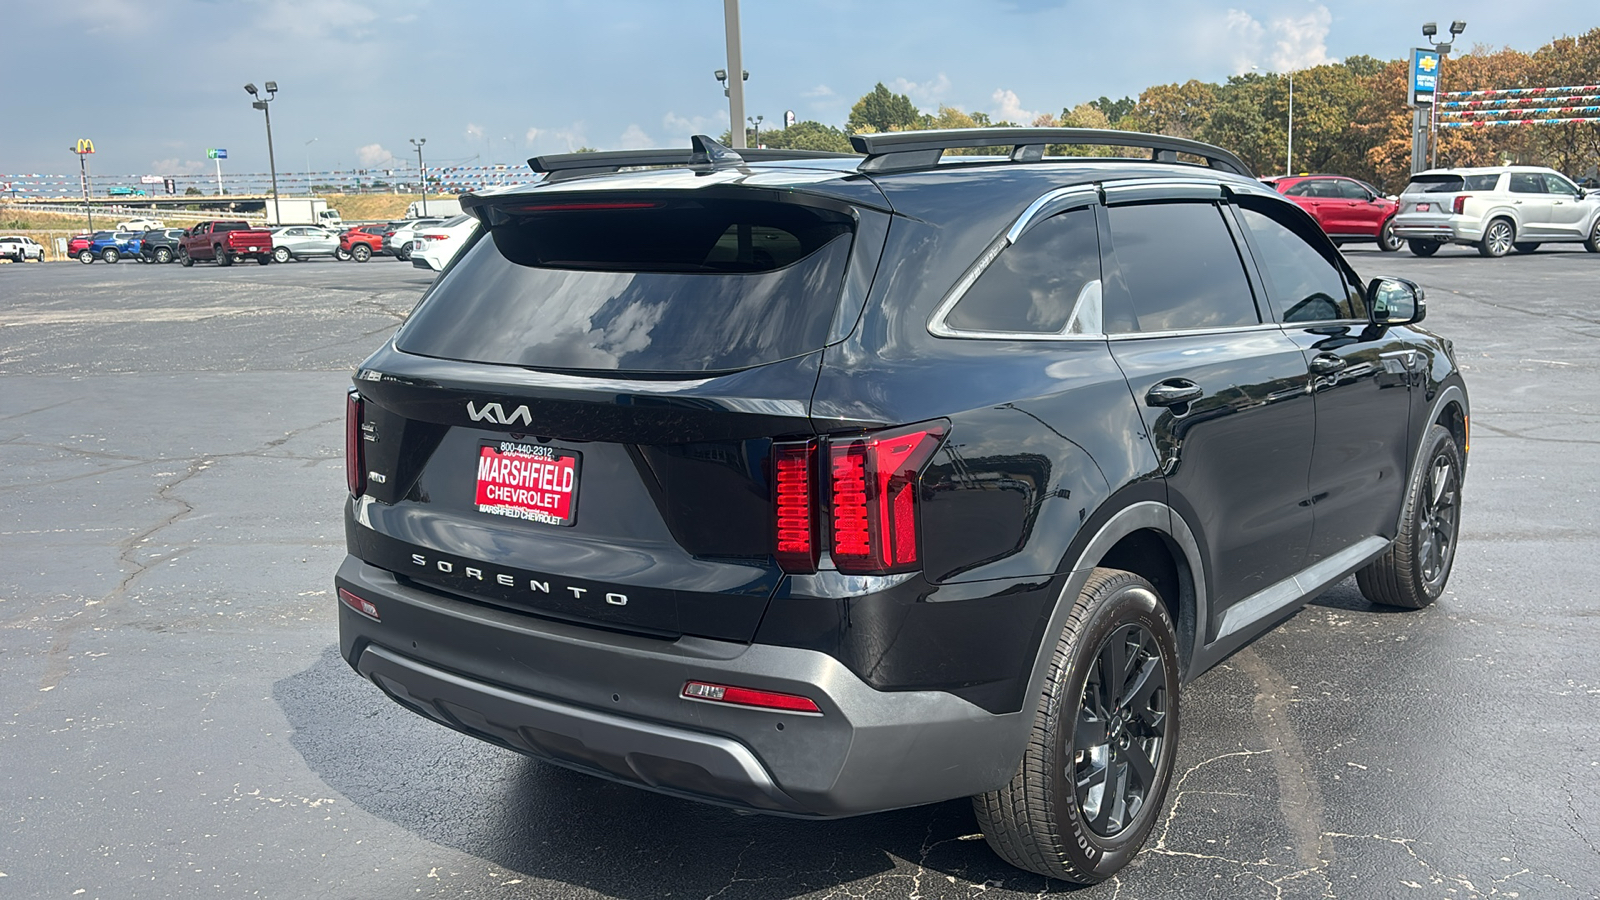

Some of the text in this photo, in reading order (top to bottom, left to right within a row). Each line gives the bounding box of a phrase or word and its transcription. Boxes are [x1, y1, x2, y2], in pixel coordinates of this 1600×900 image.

[467, 401, 532, 426] KIA
[500, 441, 553, 457] 800-440-2312
[477, 456, 574, 493] MARSHFIELD
[486, 484, 561, 508] CHEVROLET
[479, 504, 520, 518] MARSHFIELD
[521, 511, 562, 525] CHEVROLET
[411, 553, 628, 606] SORENTO
